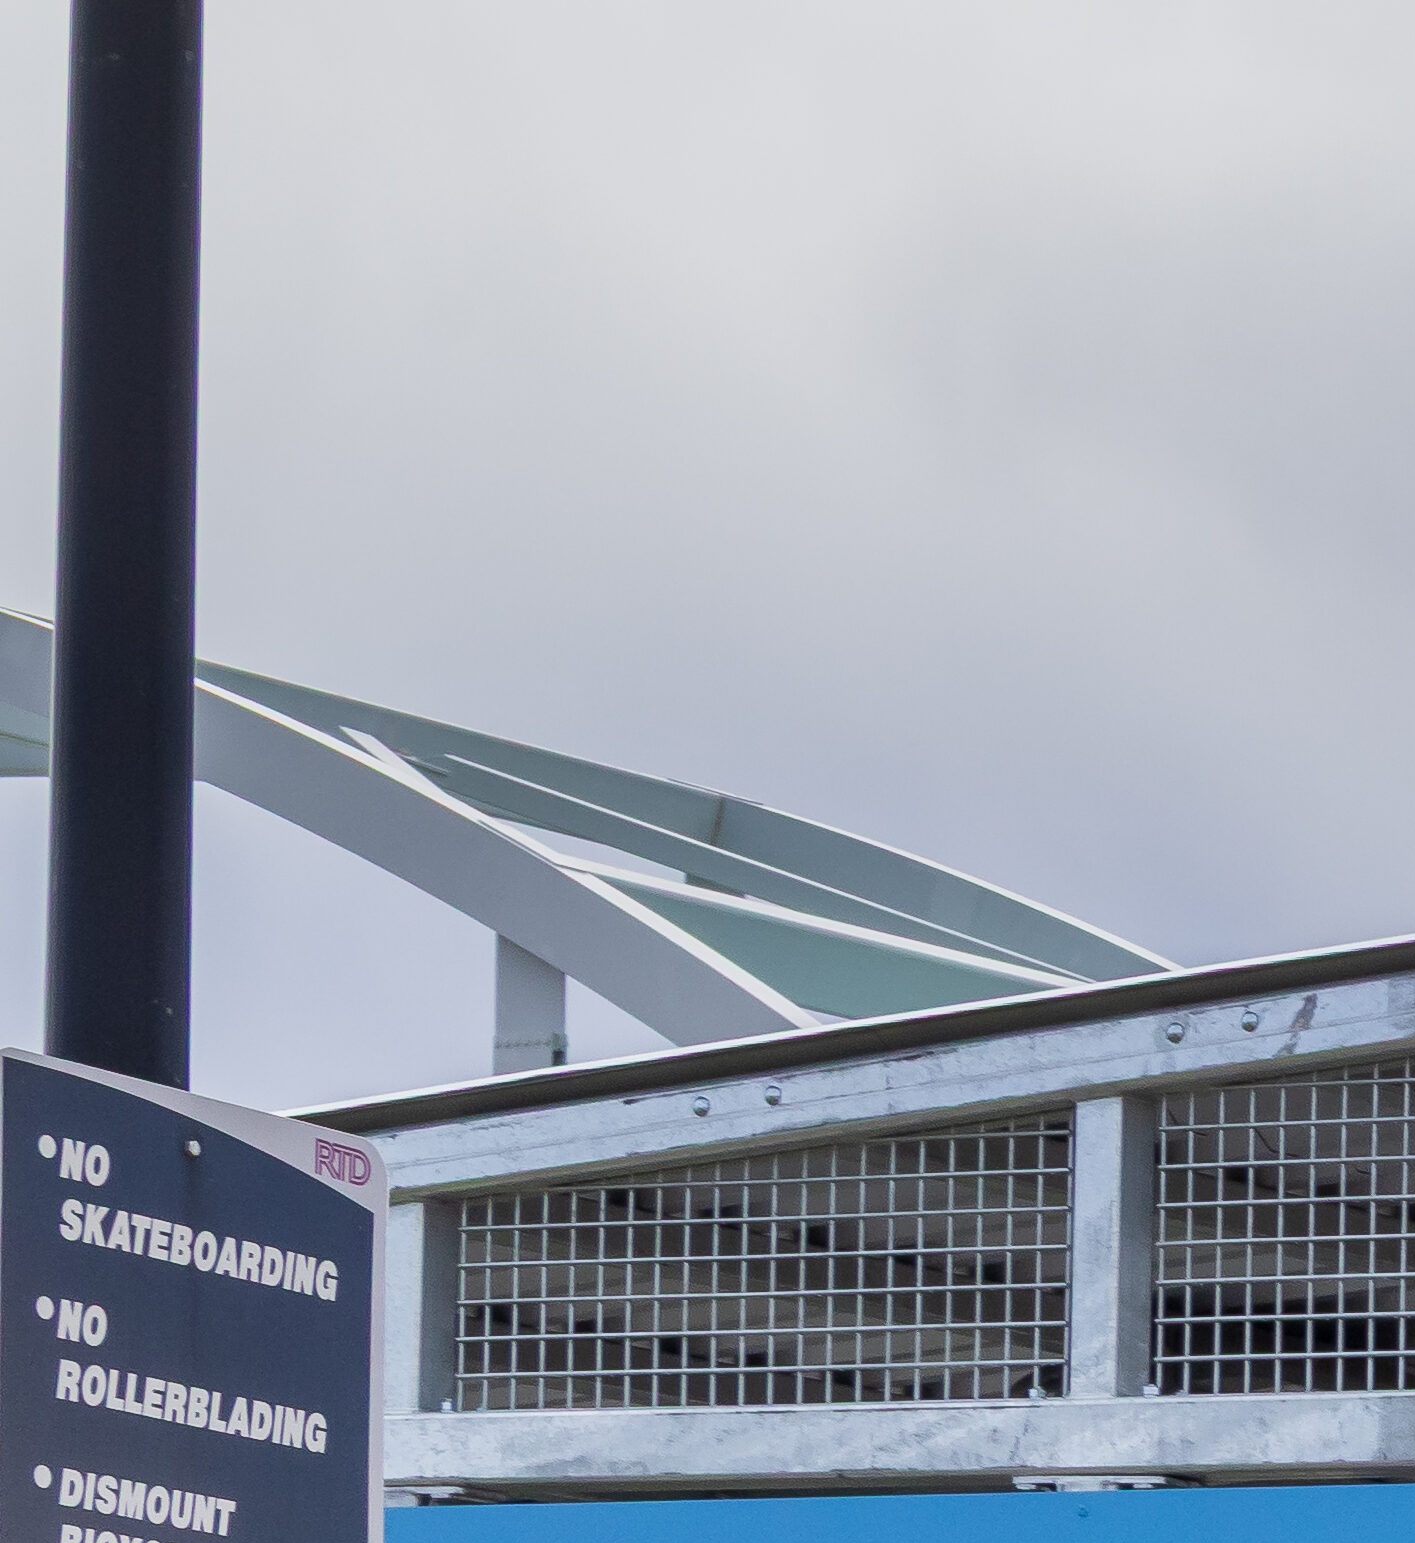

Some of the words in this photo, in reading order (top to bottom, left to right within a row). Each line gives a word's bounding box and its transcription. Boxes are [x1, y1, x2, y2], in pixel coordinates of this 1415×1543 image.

[59, 1137, 110, 1186] NO
[315, 1138, 371, 1186] RTD
[59, 1199, 338, 1302] SKATEBOARDING
[57, 1298, 107, 1347] NO
[55, 1358, 328, 1454] ROLLERBLADING
[59, 1468, 237, 1537] DISMOUNT
